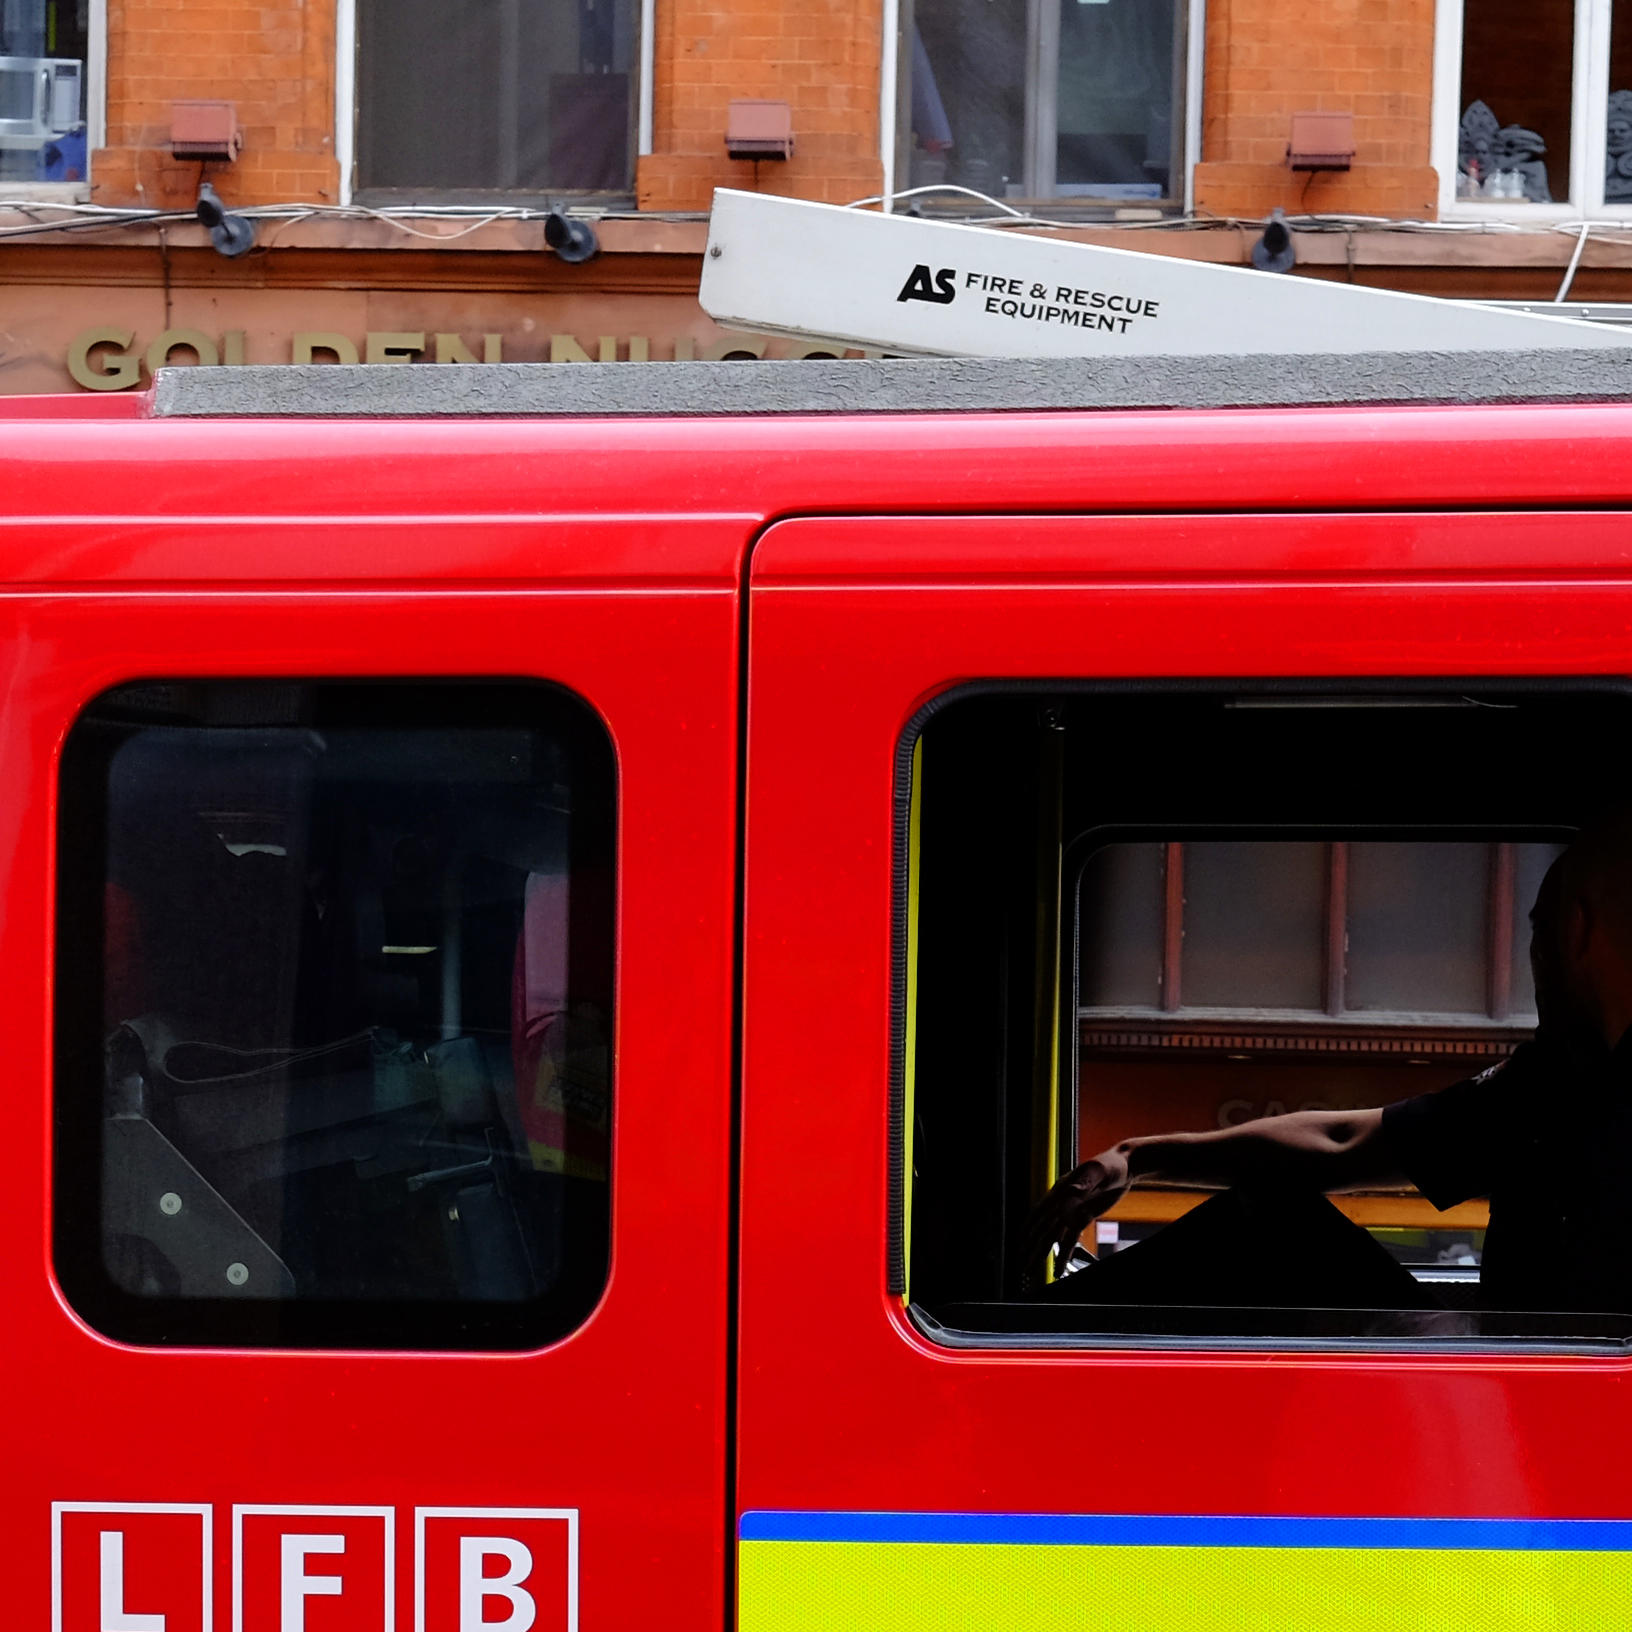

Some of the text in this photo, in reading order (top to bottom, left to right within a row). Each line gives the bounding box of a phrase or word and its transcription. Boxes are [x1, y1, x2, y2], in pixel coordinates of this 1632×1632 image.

[897, 264, 1160, 318] AS FIRE & RESCUE
[985, 297, 1133, 334] EQUIPMENT
